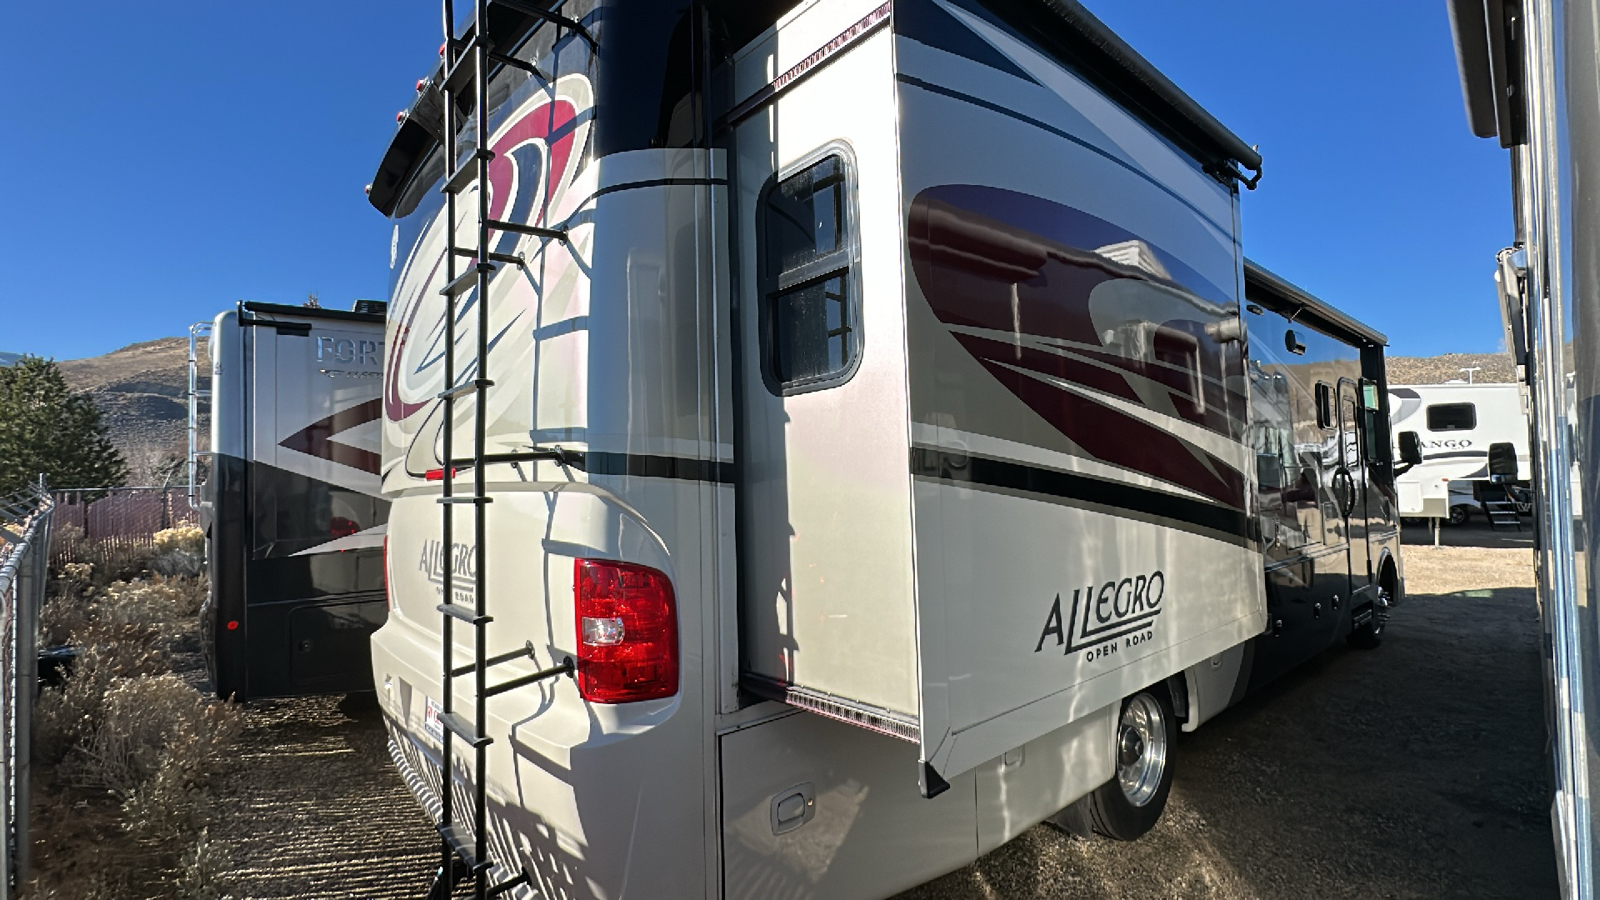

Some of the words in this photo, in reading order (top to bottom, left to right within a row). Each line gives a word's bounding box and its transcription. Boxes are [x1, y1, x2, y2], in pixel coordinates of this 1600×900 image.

[1034, 570, 1165, 656] ALLEGRO
[1086, 642, 1118, 662] OPEN
[1126, 631, 1154, 648] ROAD
